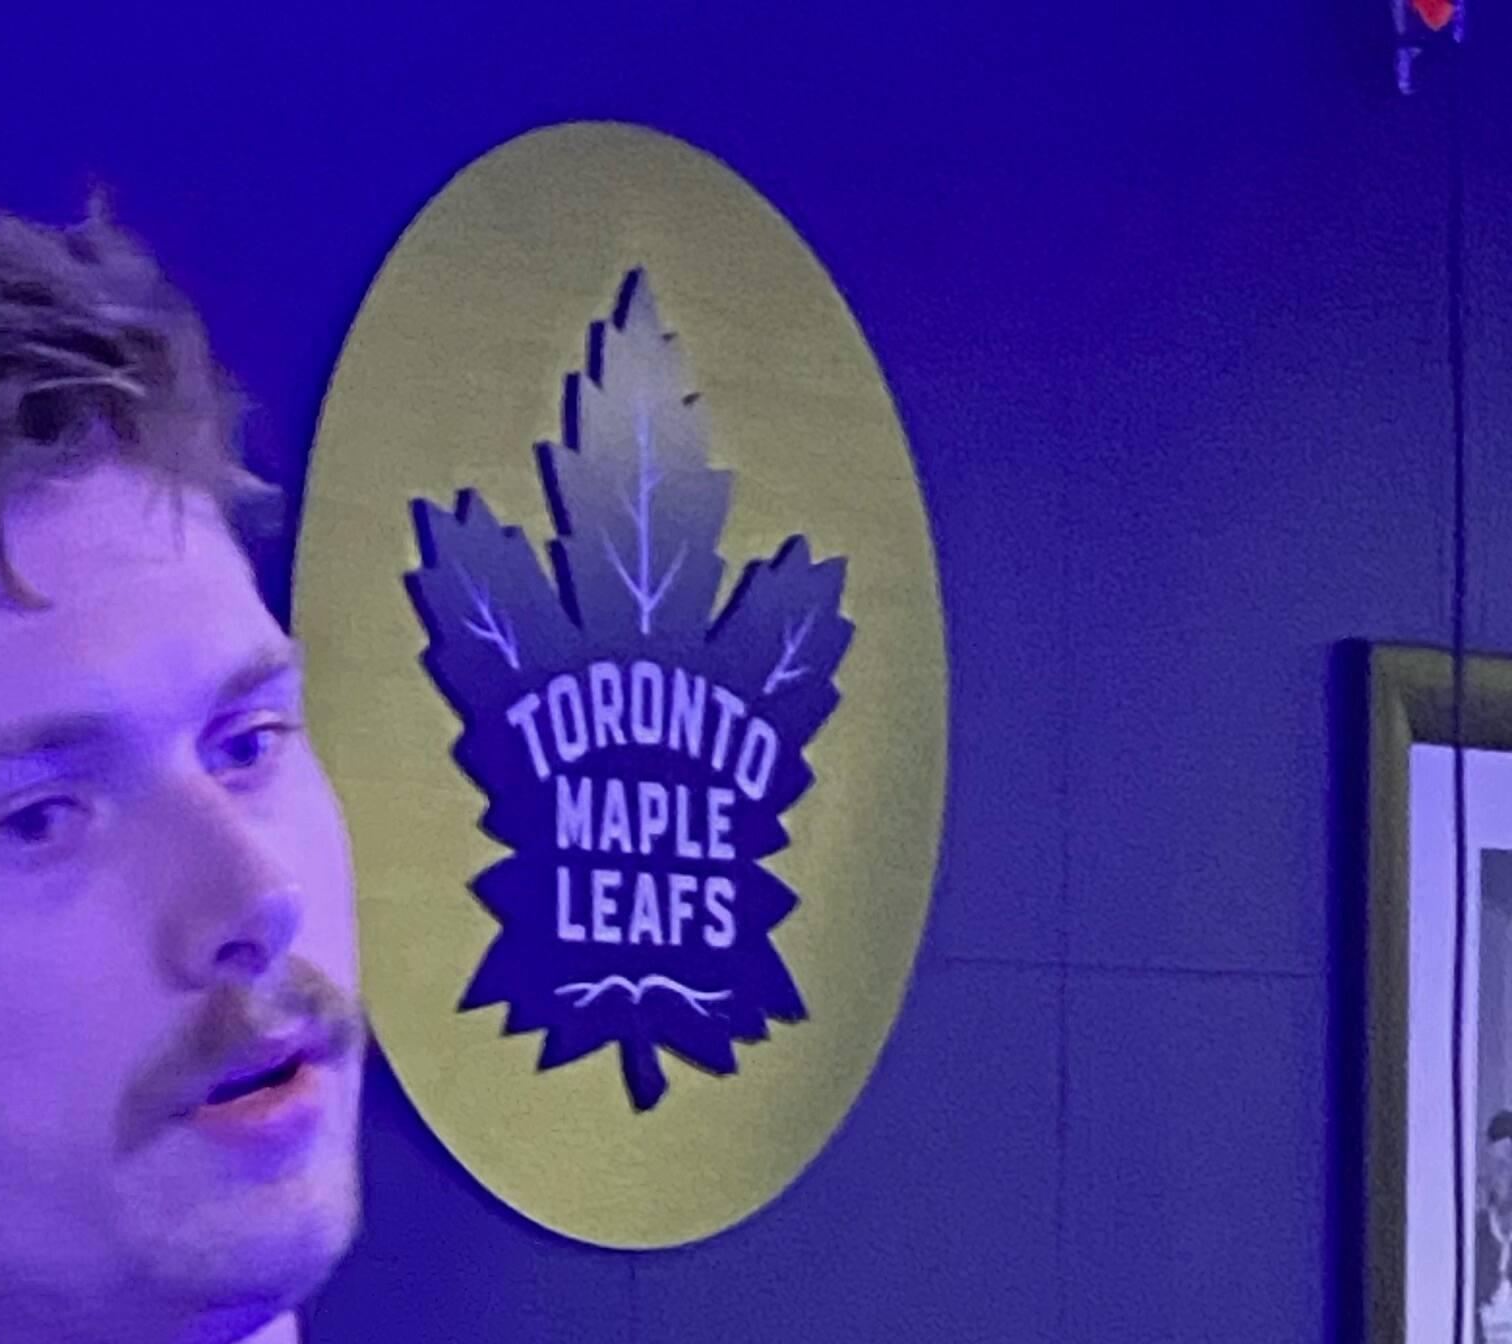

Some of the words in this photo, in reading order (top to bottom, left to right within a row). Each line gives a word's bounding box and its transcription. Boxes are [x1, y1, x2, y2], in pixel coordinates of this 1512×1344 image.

[506, 661, 780, 801] TORONTO
[555, 775, 737, 860] MAPLE
[556, 866, 738, 949] LEAFS
